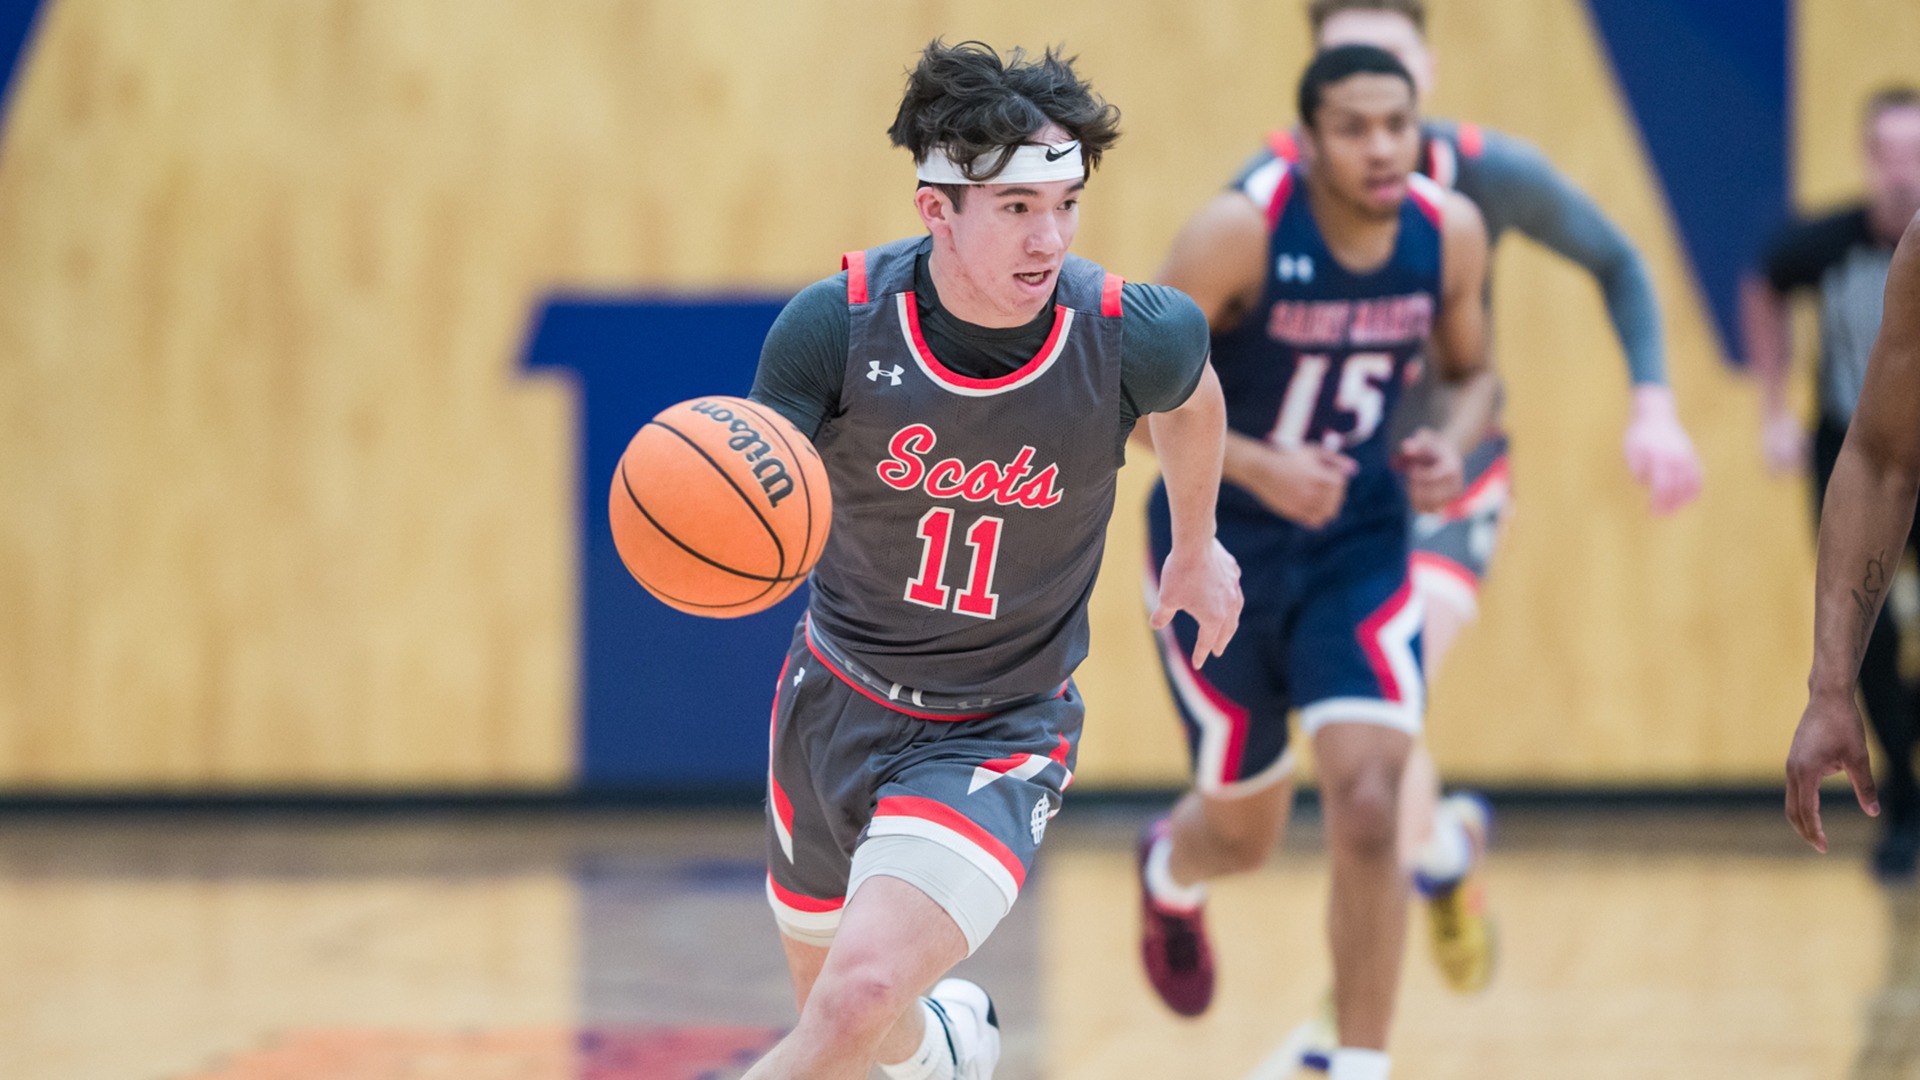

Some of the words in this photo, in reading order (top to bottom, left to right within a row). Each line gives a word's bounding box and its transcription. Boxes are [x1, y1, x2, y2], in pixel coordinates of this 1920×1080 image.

[1266, 353, 1394, 450] 15
[691, 401, 794, 509] Wilson
[876, 423, 1064, 509] Scots
[903, 506, 1004, 620] 11
